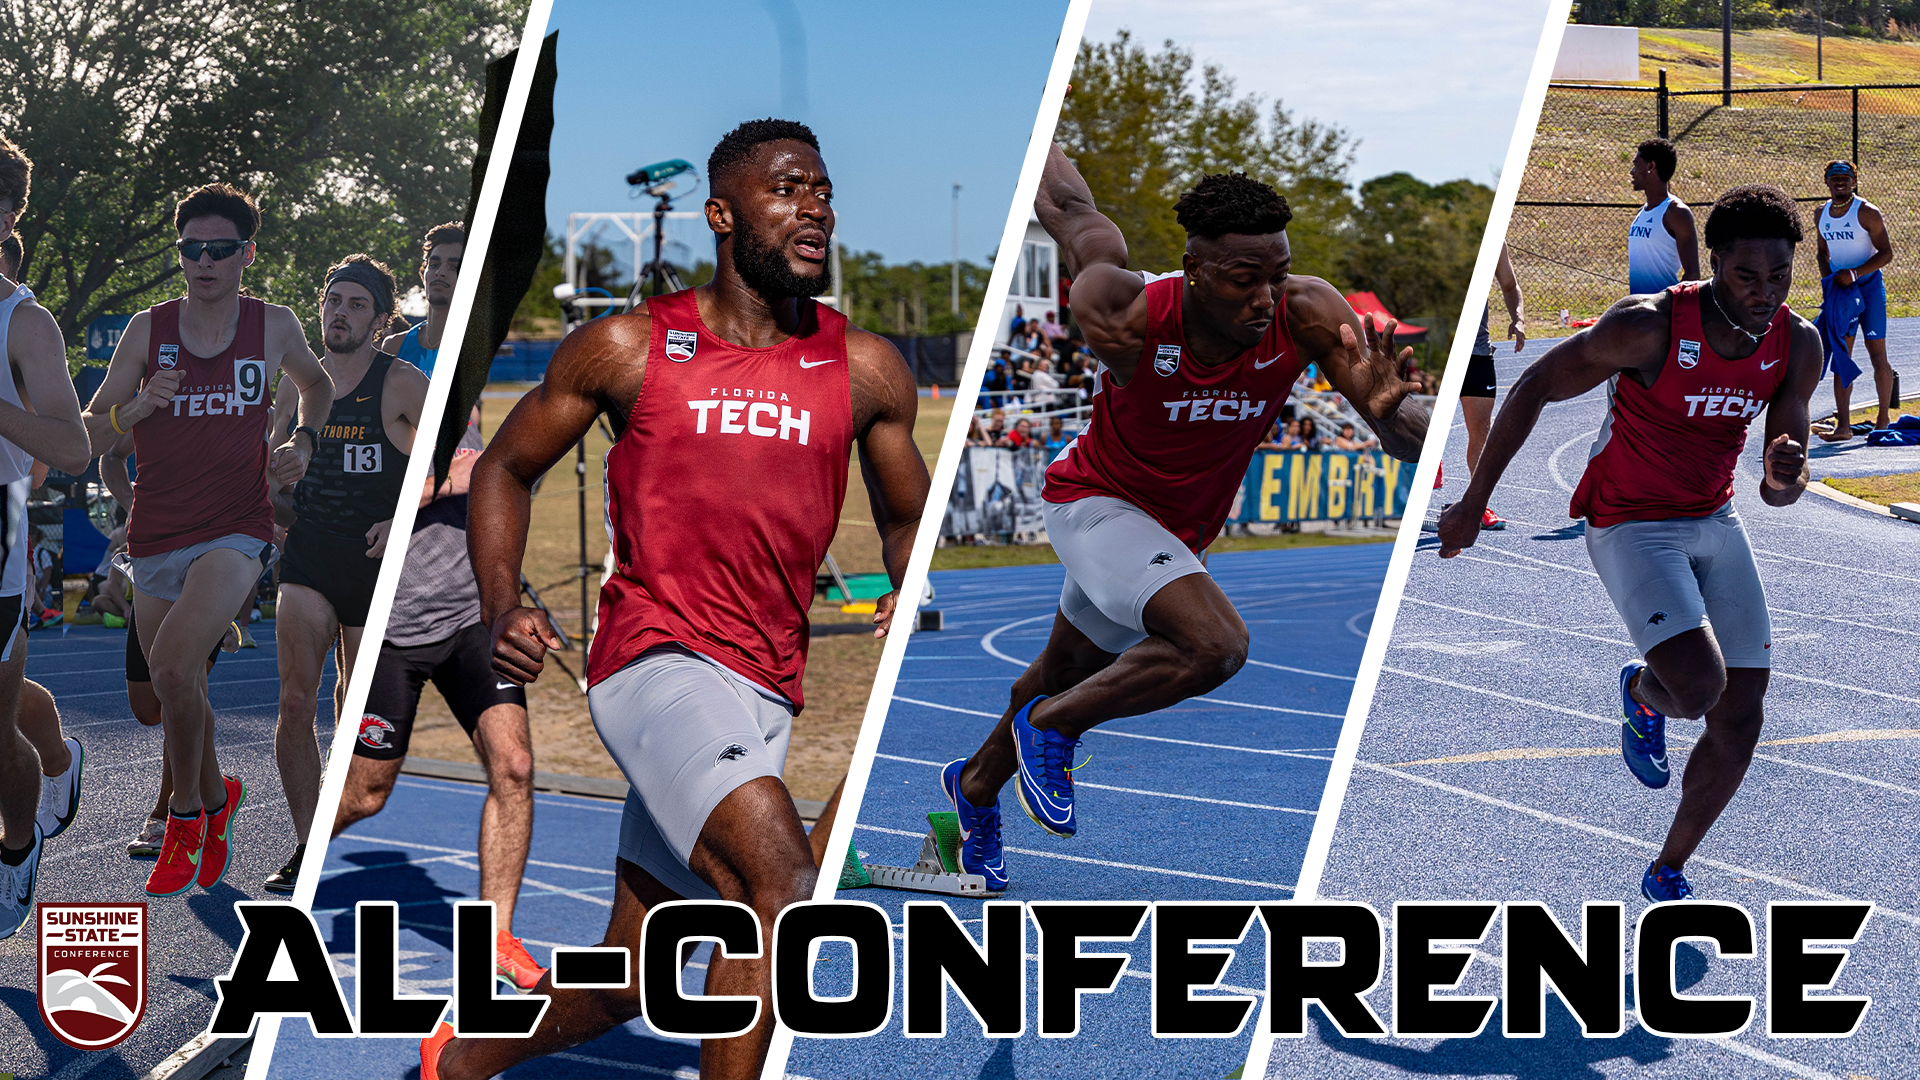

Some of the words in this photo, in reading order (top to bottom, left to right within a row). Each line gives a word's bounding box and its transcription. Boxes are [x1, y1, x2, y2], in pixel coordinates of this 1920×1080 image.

[1823, 231, 1855, 241] LYNN
[181, 384, 232, 393] FLORIDA
[239, 363, 262, 402] 9
[1701, 387, 1754, 397] FLORIDA
[710, 387, 789, 401] FLORIDA
[1182, 389, 1249, 399] FLORIDA
[1162, 398, 1267, 422] TECH
[1683, 395, 1764, 418] TECH
[687, 399, 811, 446] TECH
[319, 425, 366, 440] THORPE
[346, 445, 377, 472] 13
[1260, 454, 1400, 521] EMBRY
